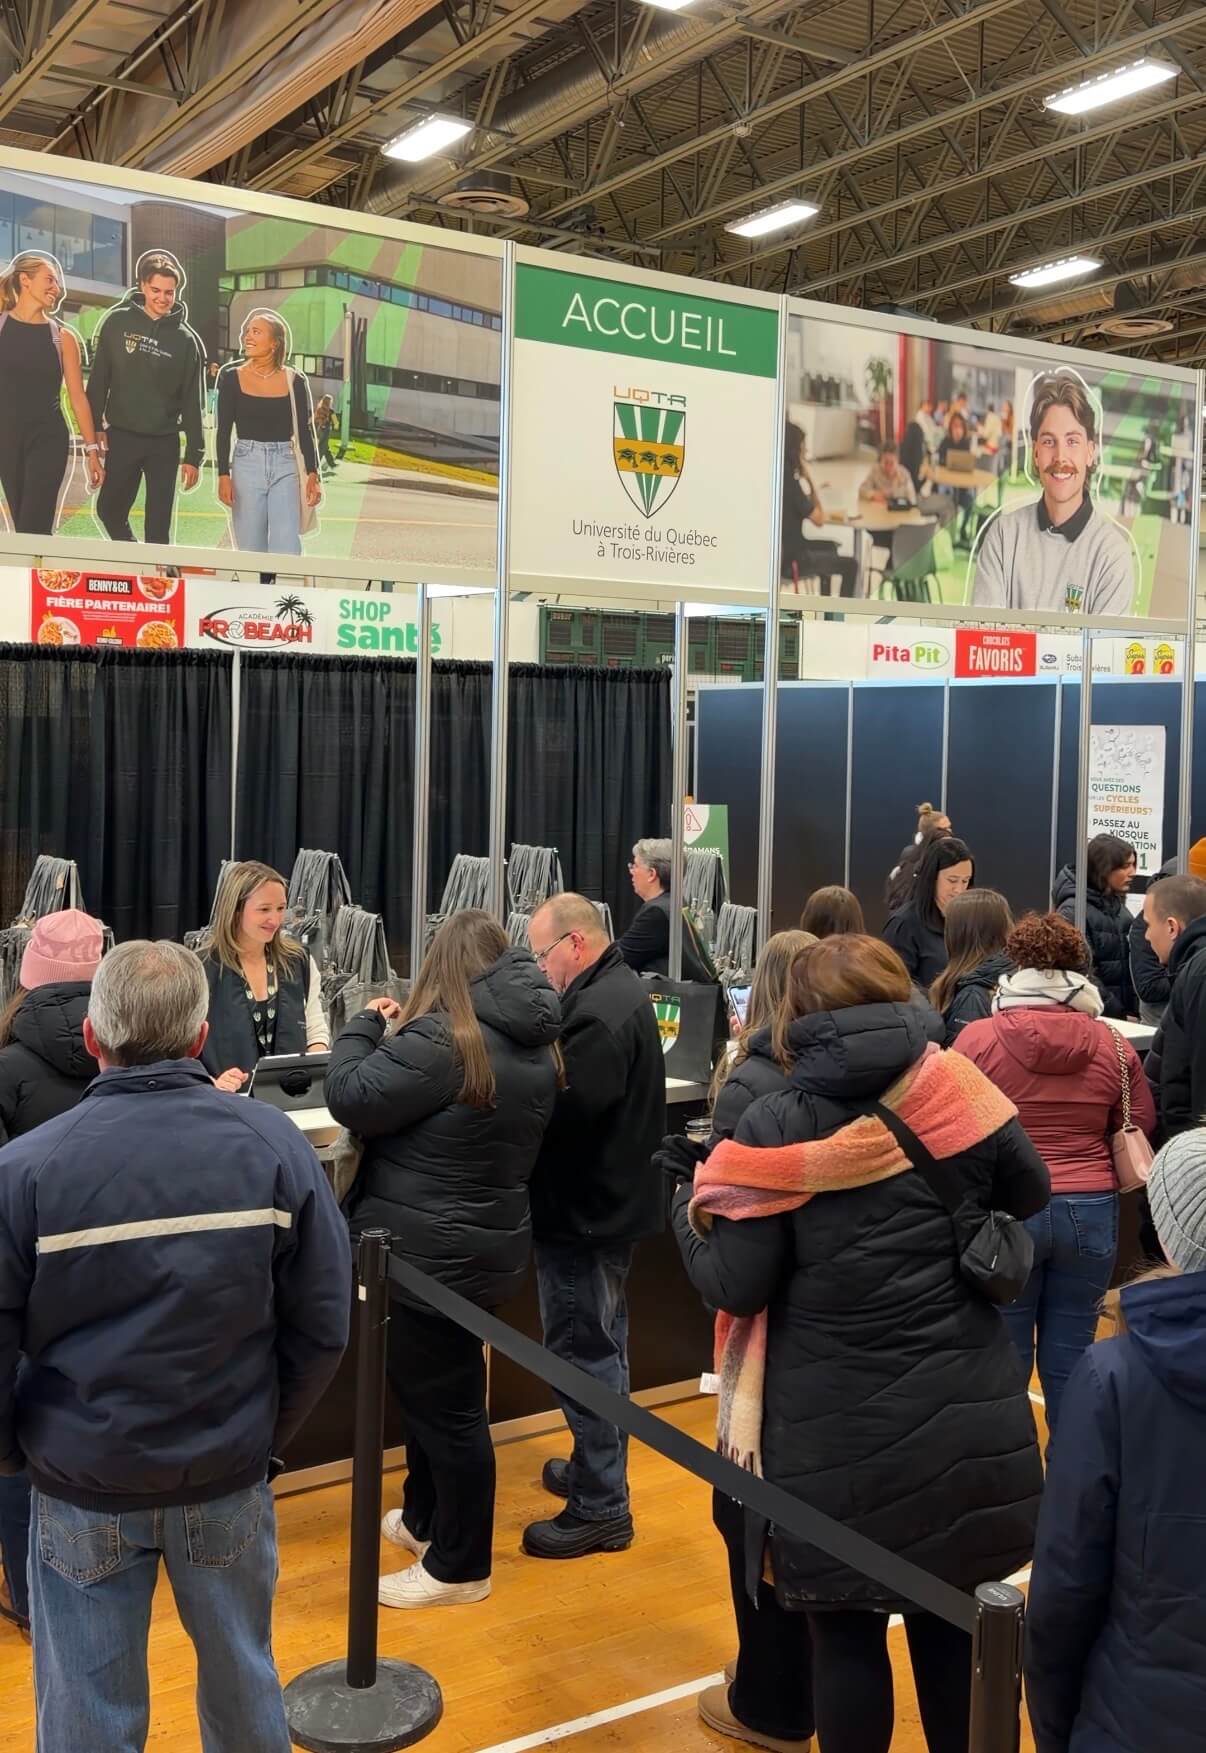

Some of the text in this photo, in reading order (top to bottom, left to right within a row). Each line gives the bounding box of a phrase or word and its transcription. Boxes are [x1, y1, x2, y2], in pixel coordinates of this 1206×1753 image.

[562, 292, 737, 356] ACCUEIL
[613, 385, 687, 407] UQTR
[572, 519, 718, 548] Université du Québec
[597, 541, 696, 565] à Trois-Rivières
[88, 578, 131, 593] BENNY&CO.
[46, 596, 171, 613] FIÈRE PARTENAIRE!
[338, 598, 391, 621] SHOP
[872, 644, 941, 664] Pita Pit
[968, 645, 1024, 672] FAVORIS
[1091, 783, 1141, 793] QUESTIONS
[1106, 795, 1140, 803] CYCLES
[1092, 818, 1140, 829] PASSEZ AU
[1110, 829, 1149, 840] KIOSQUE
